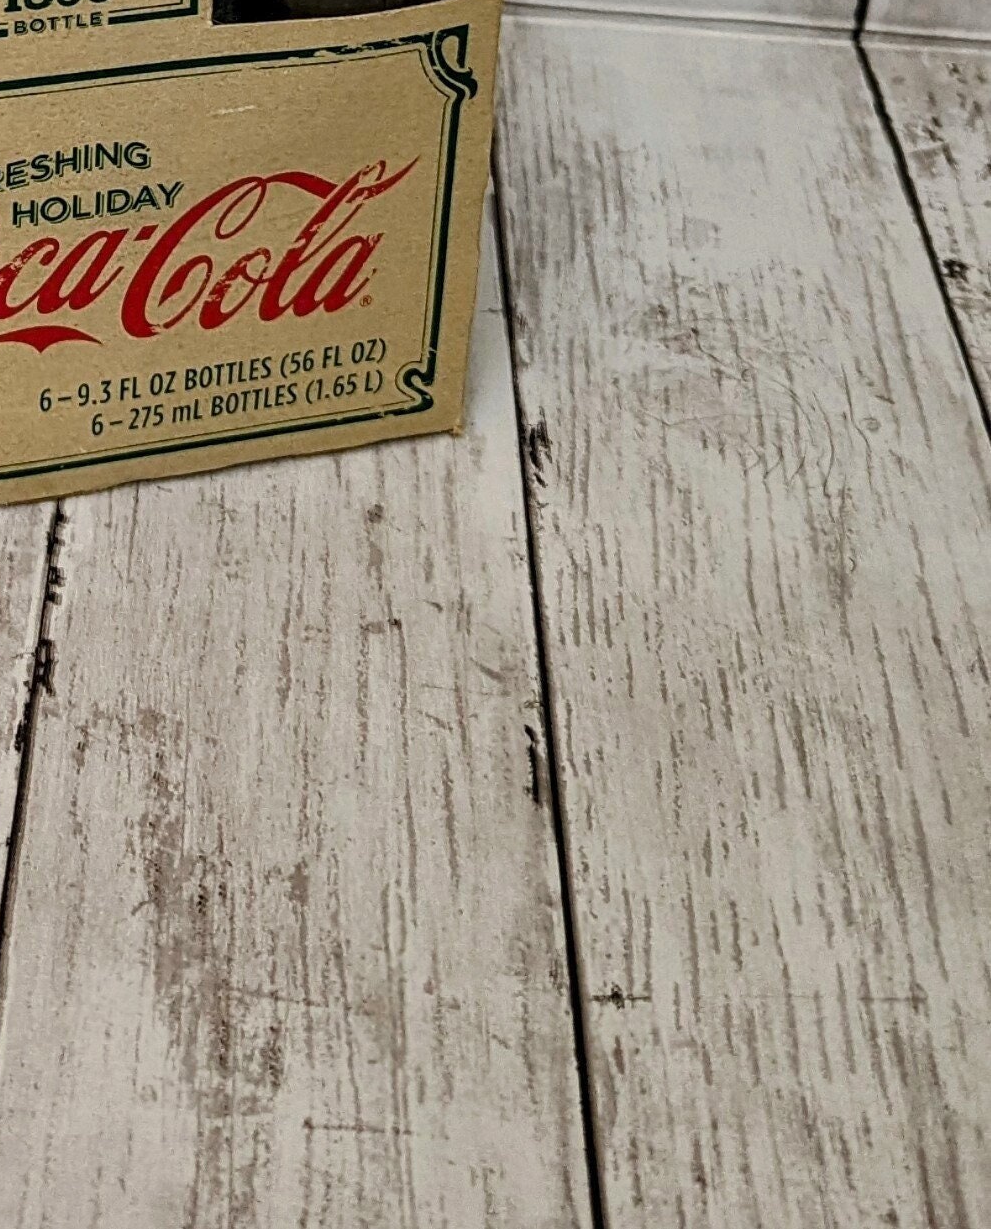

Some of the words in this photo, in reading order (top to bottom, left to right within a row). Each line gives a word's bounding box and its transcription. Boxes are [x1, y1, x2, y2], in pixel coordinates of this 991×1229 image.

[13, 11, 103, 36] BOTTLE
[12, 181, 184, 228] HOLIDAY
[119, 375, 142, 402] FL
[149, 370, 177, 397] OZ
[184, 355, 273, 392] BOTTLES
[279, 348, 315, 379] (56
[321, 344, 344, 370] FL
[351, 336, 387, 365] OZ)
[171, 399, 203, 425] mL
[210, 382, 299, 418] BOTTLES
[304, 373, 358, 406] (1.65
[363, 370, 384, 395] L)
